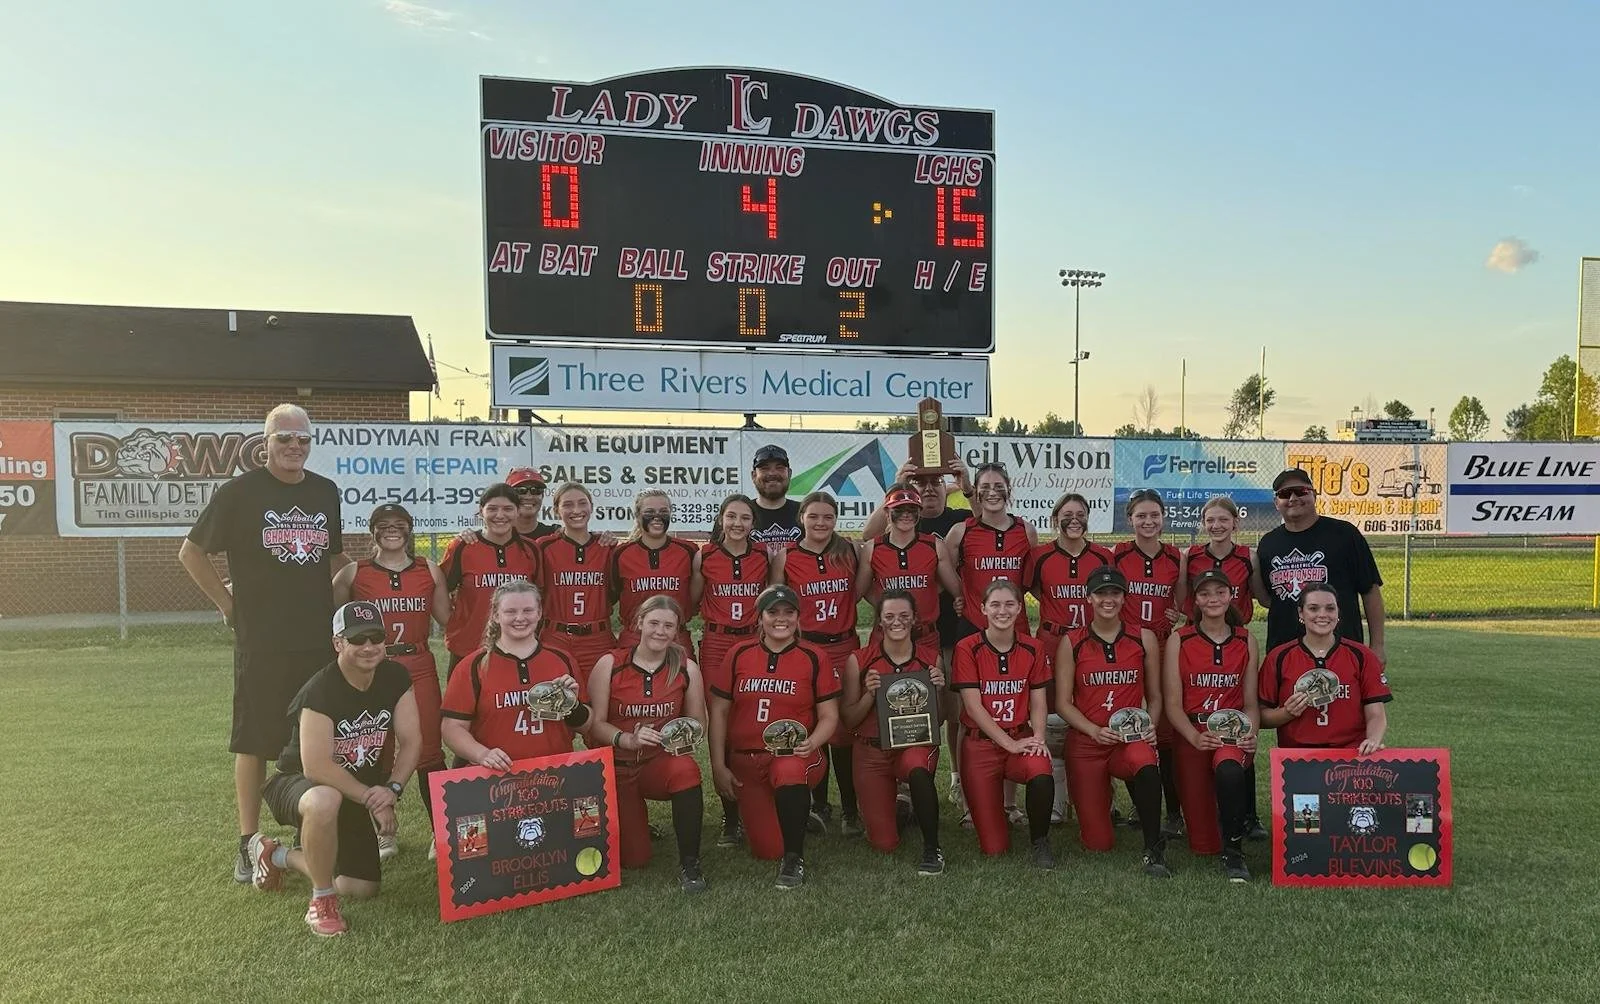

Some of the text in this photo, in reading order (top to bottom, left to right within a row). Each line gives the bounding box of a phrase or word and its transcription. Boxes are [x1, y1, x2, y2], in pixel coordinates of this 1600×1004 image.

[547, 86, 697, 130] LADY
[791, 103, 940, 146] DAWGS
[489, 129, 606, 164] VISITOR
[699, 141, 805, 177] INNING
[915, 154, 984, 186] LCHS
[541, 164, 580, 229] 0
[742, 178, 777, 239] 4
[936, 186, 985, 248] 15
[490, 242, 599, 277] AT BAT
[617, 247, 689, 281] BALL
[706, 252, 806, 286] STRIKE
[826, 257, 881, 288] OUT
[914, 260, 935, 290] H
[968, 263, 988, 293] E
[633, 283, 664, 334] 0
[738, 287, 767, 336] 0
[779, 333, 828, 343] SPECTRUM
[557, 363, 974, 400] Three Rivers Medical Center
[450, 429, 527, 447] FRANK
[549, 435, 728, 455] AIR EQUIPMENT
[336, 457, 498, 475] HOME REPAIR
[1010, 442, 1112, 470] Wilson
[540, 465, 739, 485] SALES & SERVICE
[1170, 456, 1257, 479] Ferrellgas
[1463, 455, 1597, 479] BLUE LINE
[695, 488, 709, 497] KY
[1046, 473, 1114, 492] Supports
[83, 482, 162, 506] FAMILY
[1166, 491, 1185, 499] Fuel
[1187, 491, 1203, 499] Life
[96, 509, 120, 519] Tim
[124, 509, 180, 521] Gillispie
[596, 506, 635, 521] STON
[1330, 499, 1383, 515] Service
[1398, 499, 1442, 515] Repair
[1471, 500, 1576, 522] STREAM
[458, 516, 484, 527] Haulin
[1364, 519, 1442, 532] 606-316-1364
[974, 556, 1021, 570] LAWRENCE
[554, 571, 604, 586] LAWRENCE
[630, 577, 680, 593] LAWRENCE
[800, 578, 849, 597] LAWRENCE
[880, 575, 928, 590] LAWRENCE
[712, 583, 760, 597] LAWRENCE
[1128, 581, 1172, 598] AWRENCE
[373, 597, 426, 612] AWRENCE
[573, 592, 585, 616] 5
[731, 602, 743, 621] 8
[815, 598, 838, 622] 34
[392, 622, 404, 645] 2
[739, 678, 797, 695] LAWRENCE
[1083, 670, 1138, 686] LAWRENCE
[619, 701, 675, 718] LAWRENCE
[757, 698, 771, 723] 6
[992, 699, 1015, 722] 23
[1352, 777, 1374, 790] 100
[1327, 792, 1403, 805] STRIKEOUTS
[1328, 835, 1398, 854] TAYLOR
[491, 850, 568, 875] BROOKLYN
[1328, 857, 1403, 876] BLEVINS
[513, 870, 550, 890] ELLIS
